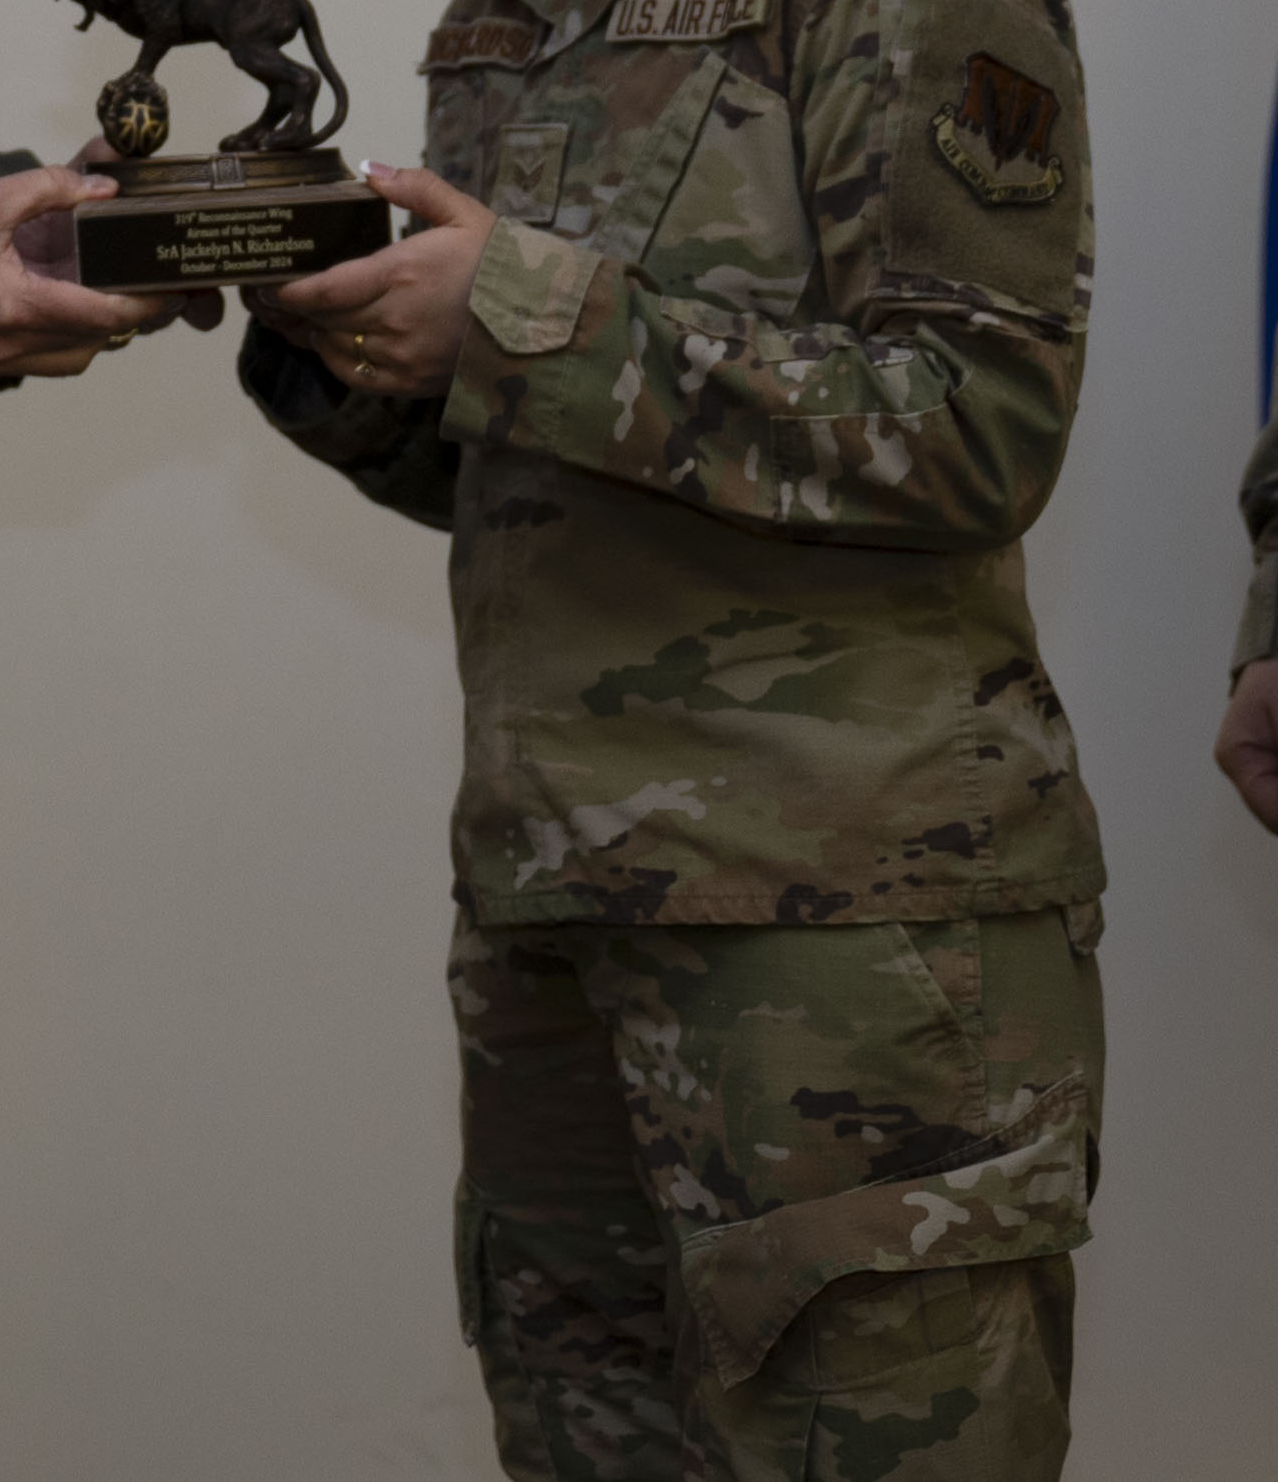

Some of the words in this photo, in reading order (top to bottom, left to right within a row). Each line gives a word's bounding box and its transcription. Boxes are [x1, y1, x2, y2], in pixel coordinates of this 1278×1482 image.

[940, 138, 962, 159] AIR
[199, 211, 267, 223] Reconnaissance
[267, 208, 294, 220] Wing
[221, 225, 230, 236] of
[231, 224, 246, 236] the
[247, 223, 283, 235] Quarter
[157, 245, 178, 259] SrA
[232, 240, 246, 254] N.
[247, 236, 315, 254] Richardson
[180, 261, 216, 274] October
[223, 258, 269, 272] December
